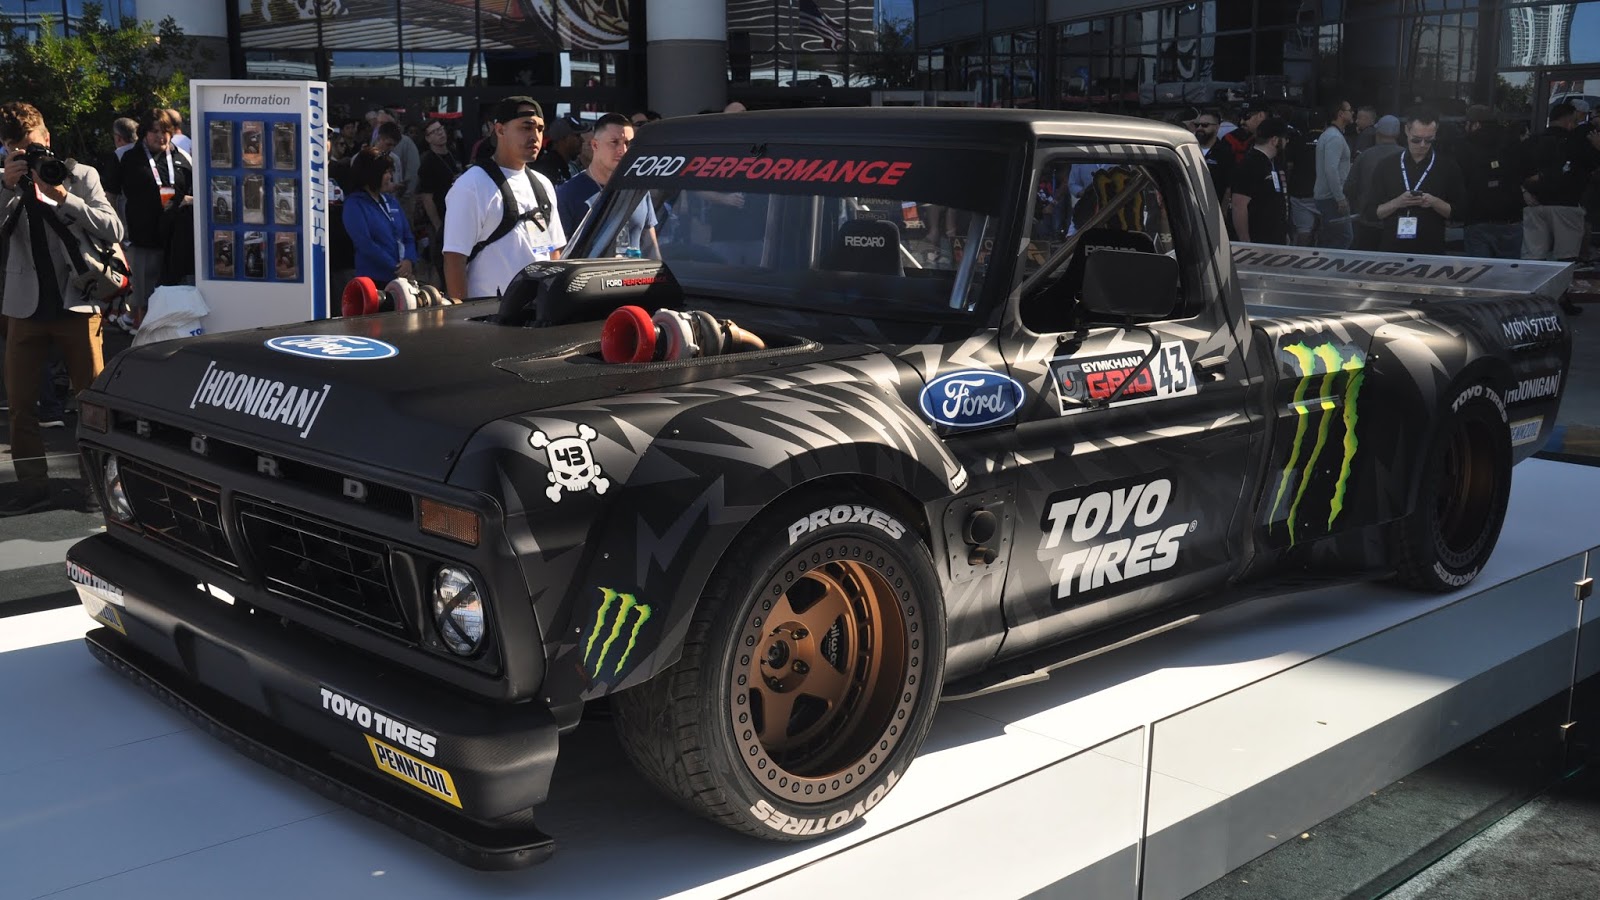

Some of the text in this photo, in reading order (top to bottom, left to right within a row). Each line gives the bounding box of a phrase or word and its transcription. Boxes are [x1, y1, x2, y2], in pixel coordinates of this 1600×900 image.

[222, 93, 291, 106] Information
[623, 155, 912, 186] FORD PERFORMANCE
[844, 235, 886, 248] RECARO
[606, 278, 622, 288] FORD
[280, 334, 375, 356] Ford
[1080, 355, 1144, 374] GYMKHANA
[1158, 345, 1189, 395] 43
[942, 378, 1006, 419] Ford
[1451, 384, 1483, 414] TOYO
[554, 445, 586, 467] 43
[787, 504, 907, 546] PROXES
[1045, 478, 1172, 550] TOYO
[66, 560, 93, 585] TOYO
[320, 687, 438, 759] TOYO TIRES
[373, 741, 453, 799] PENNZOIL
